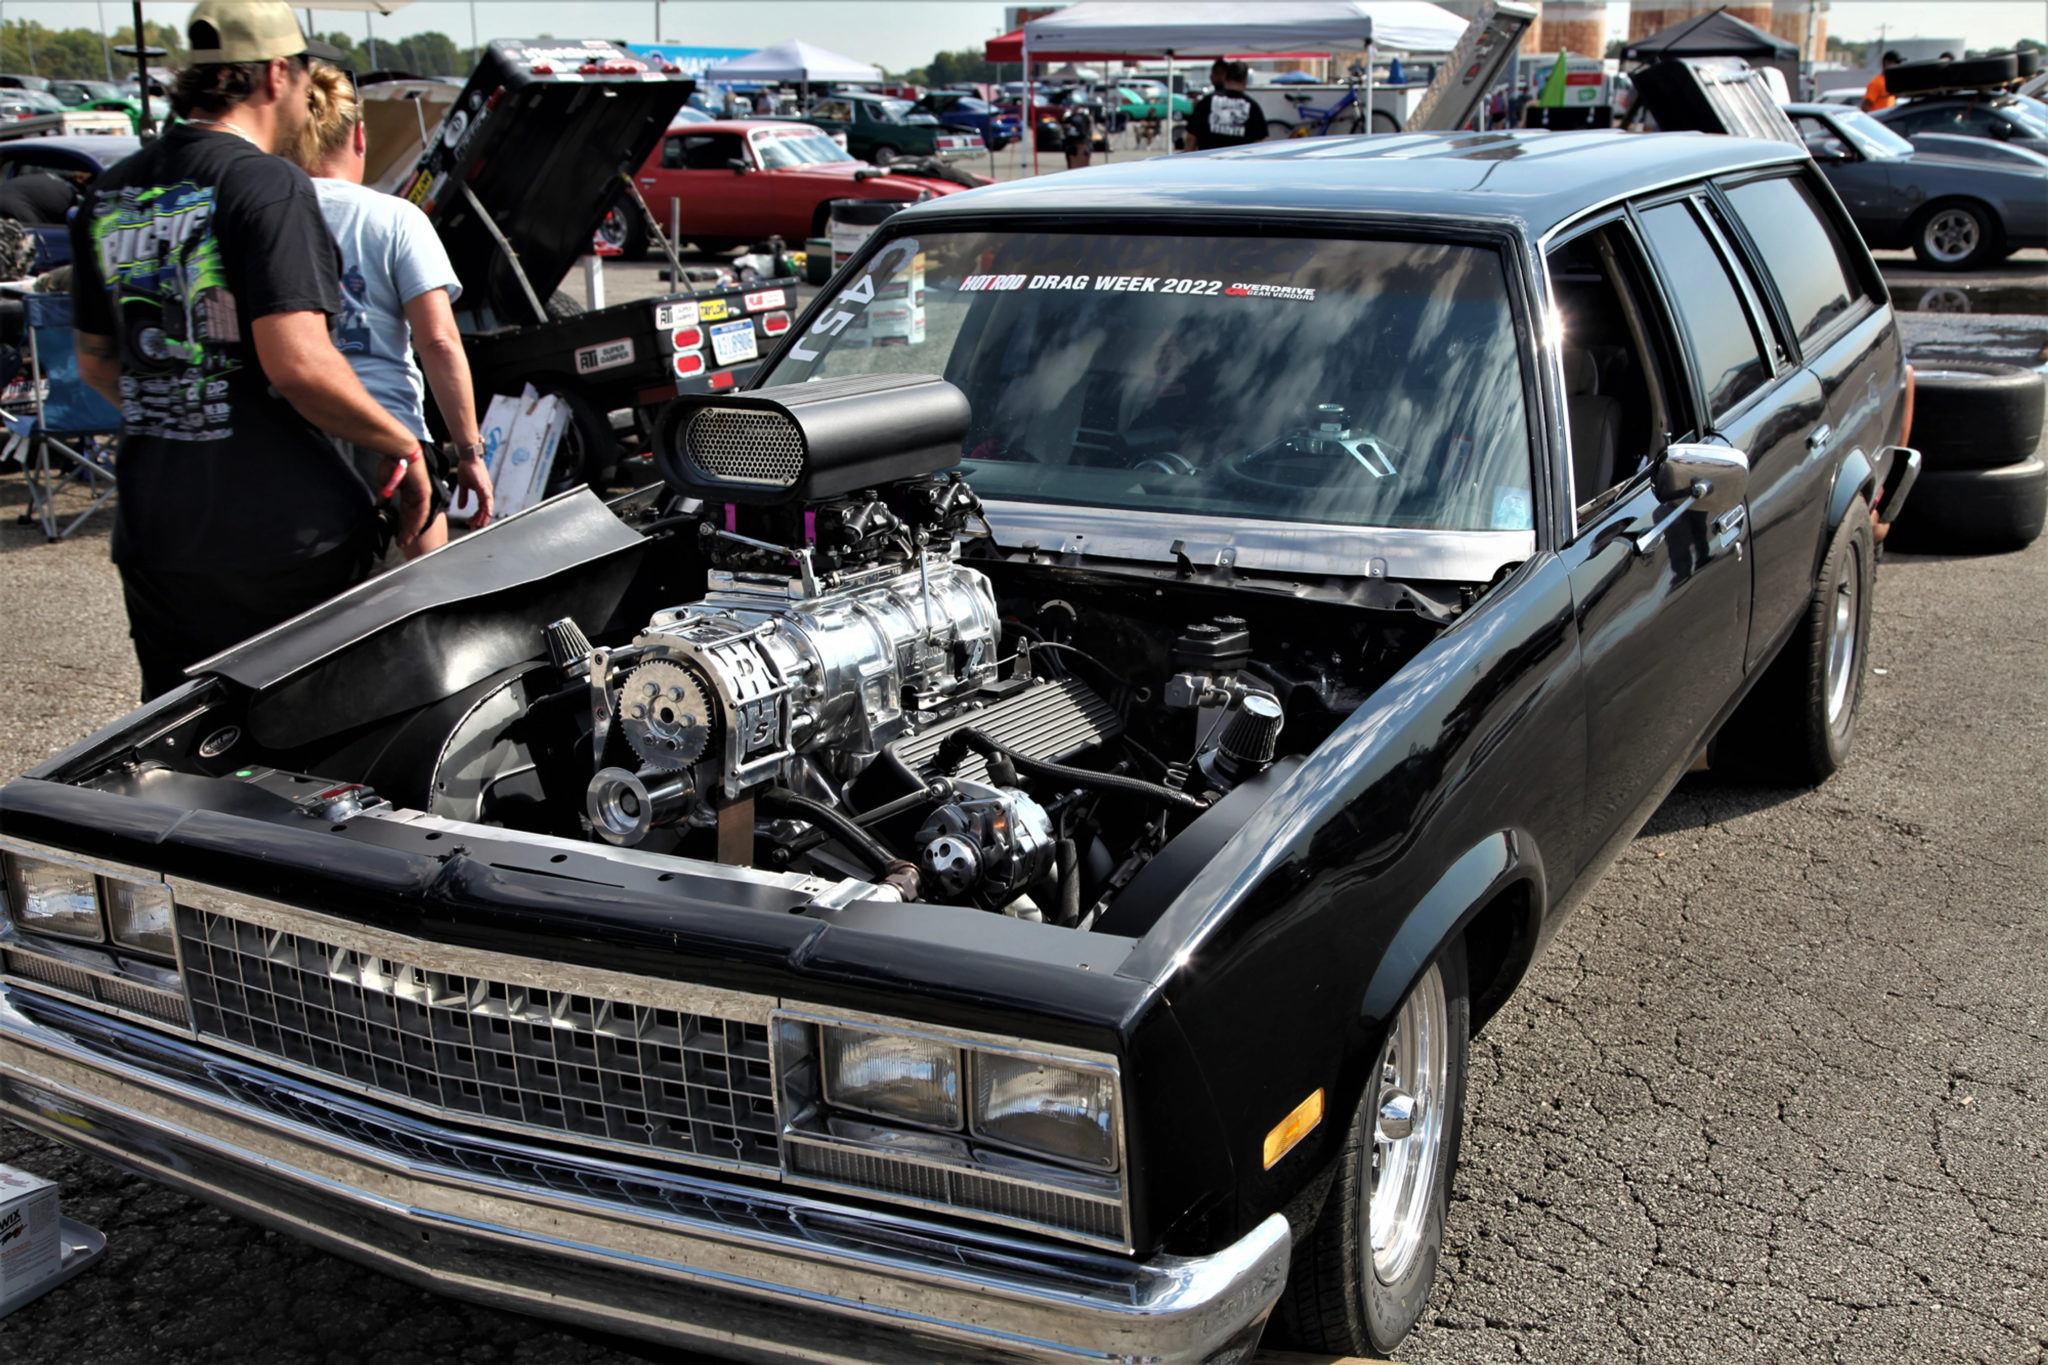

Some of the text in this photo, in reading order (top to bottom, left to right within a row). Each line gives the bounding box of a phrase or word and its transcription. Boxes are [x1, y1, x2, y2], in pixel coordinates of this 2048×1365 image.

[1027, 274, 1090, 291] DRAG
[1093, 275, 1161, 293] WEEK
[1160, 278, 1223, 296] 2022
[1230, 282, 1317, 297] OVERDRIVE
[1247, 289, 1316, 302] GEAR VENDORS
[700, 303, 727, 317] TAYLOR
[602, 343, 626, 356] SUPER
[600, 351, 631, 365] DAMPER
